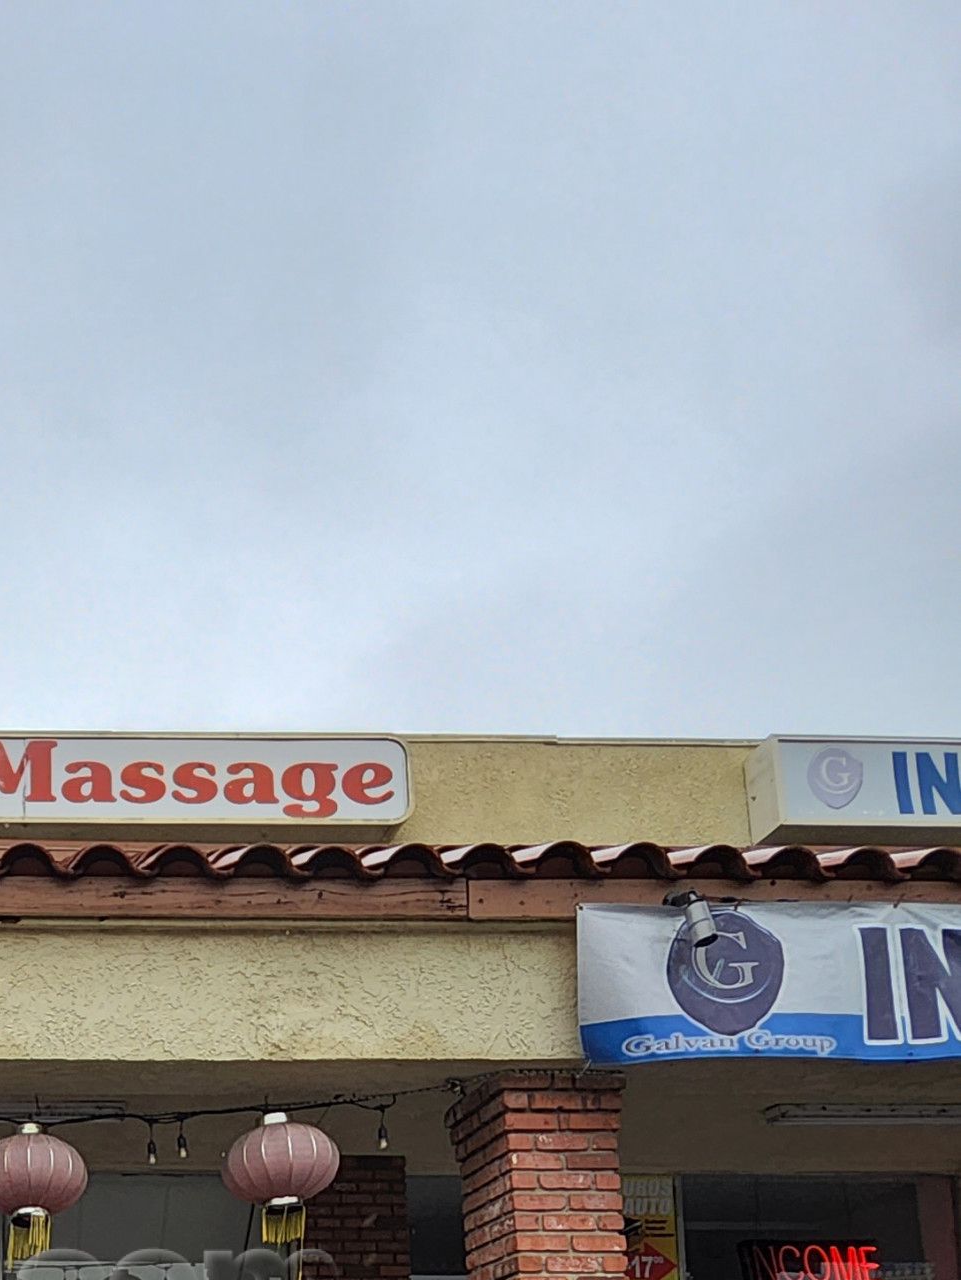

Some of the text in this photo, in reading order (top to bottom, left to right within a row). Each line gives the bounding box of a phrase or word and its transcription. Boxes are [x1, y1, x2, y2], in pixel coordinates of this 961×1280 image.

[891, 751, 961, 815] IN
[856, 925, 961, 1043] IN
[623, 1026, 837, 1054] Galvan Group
